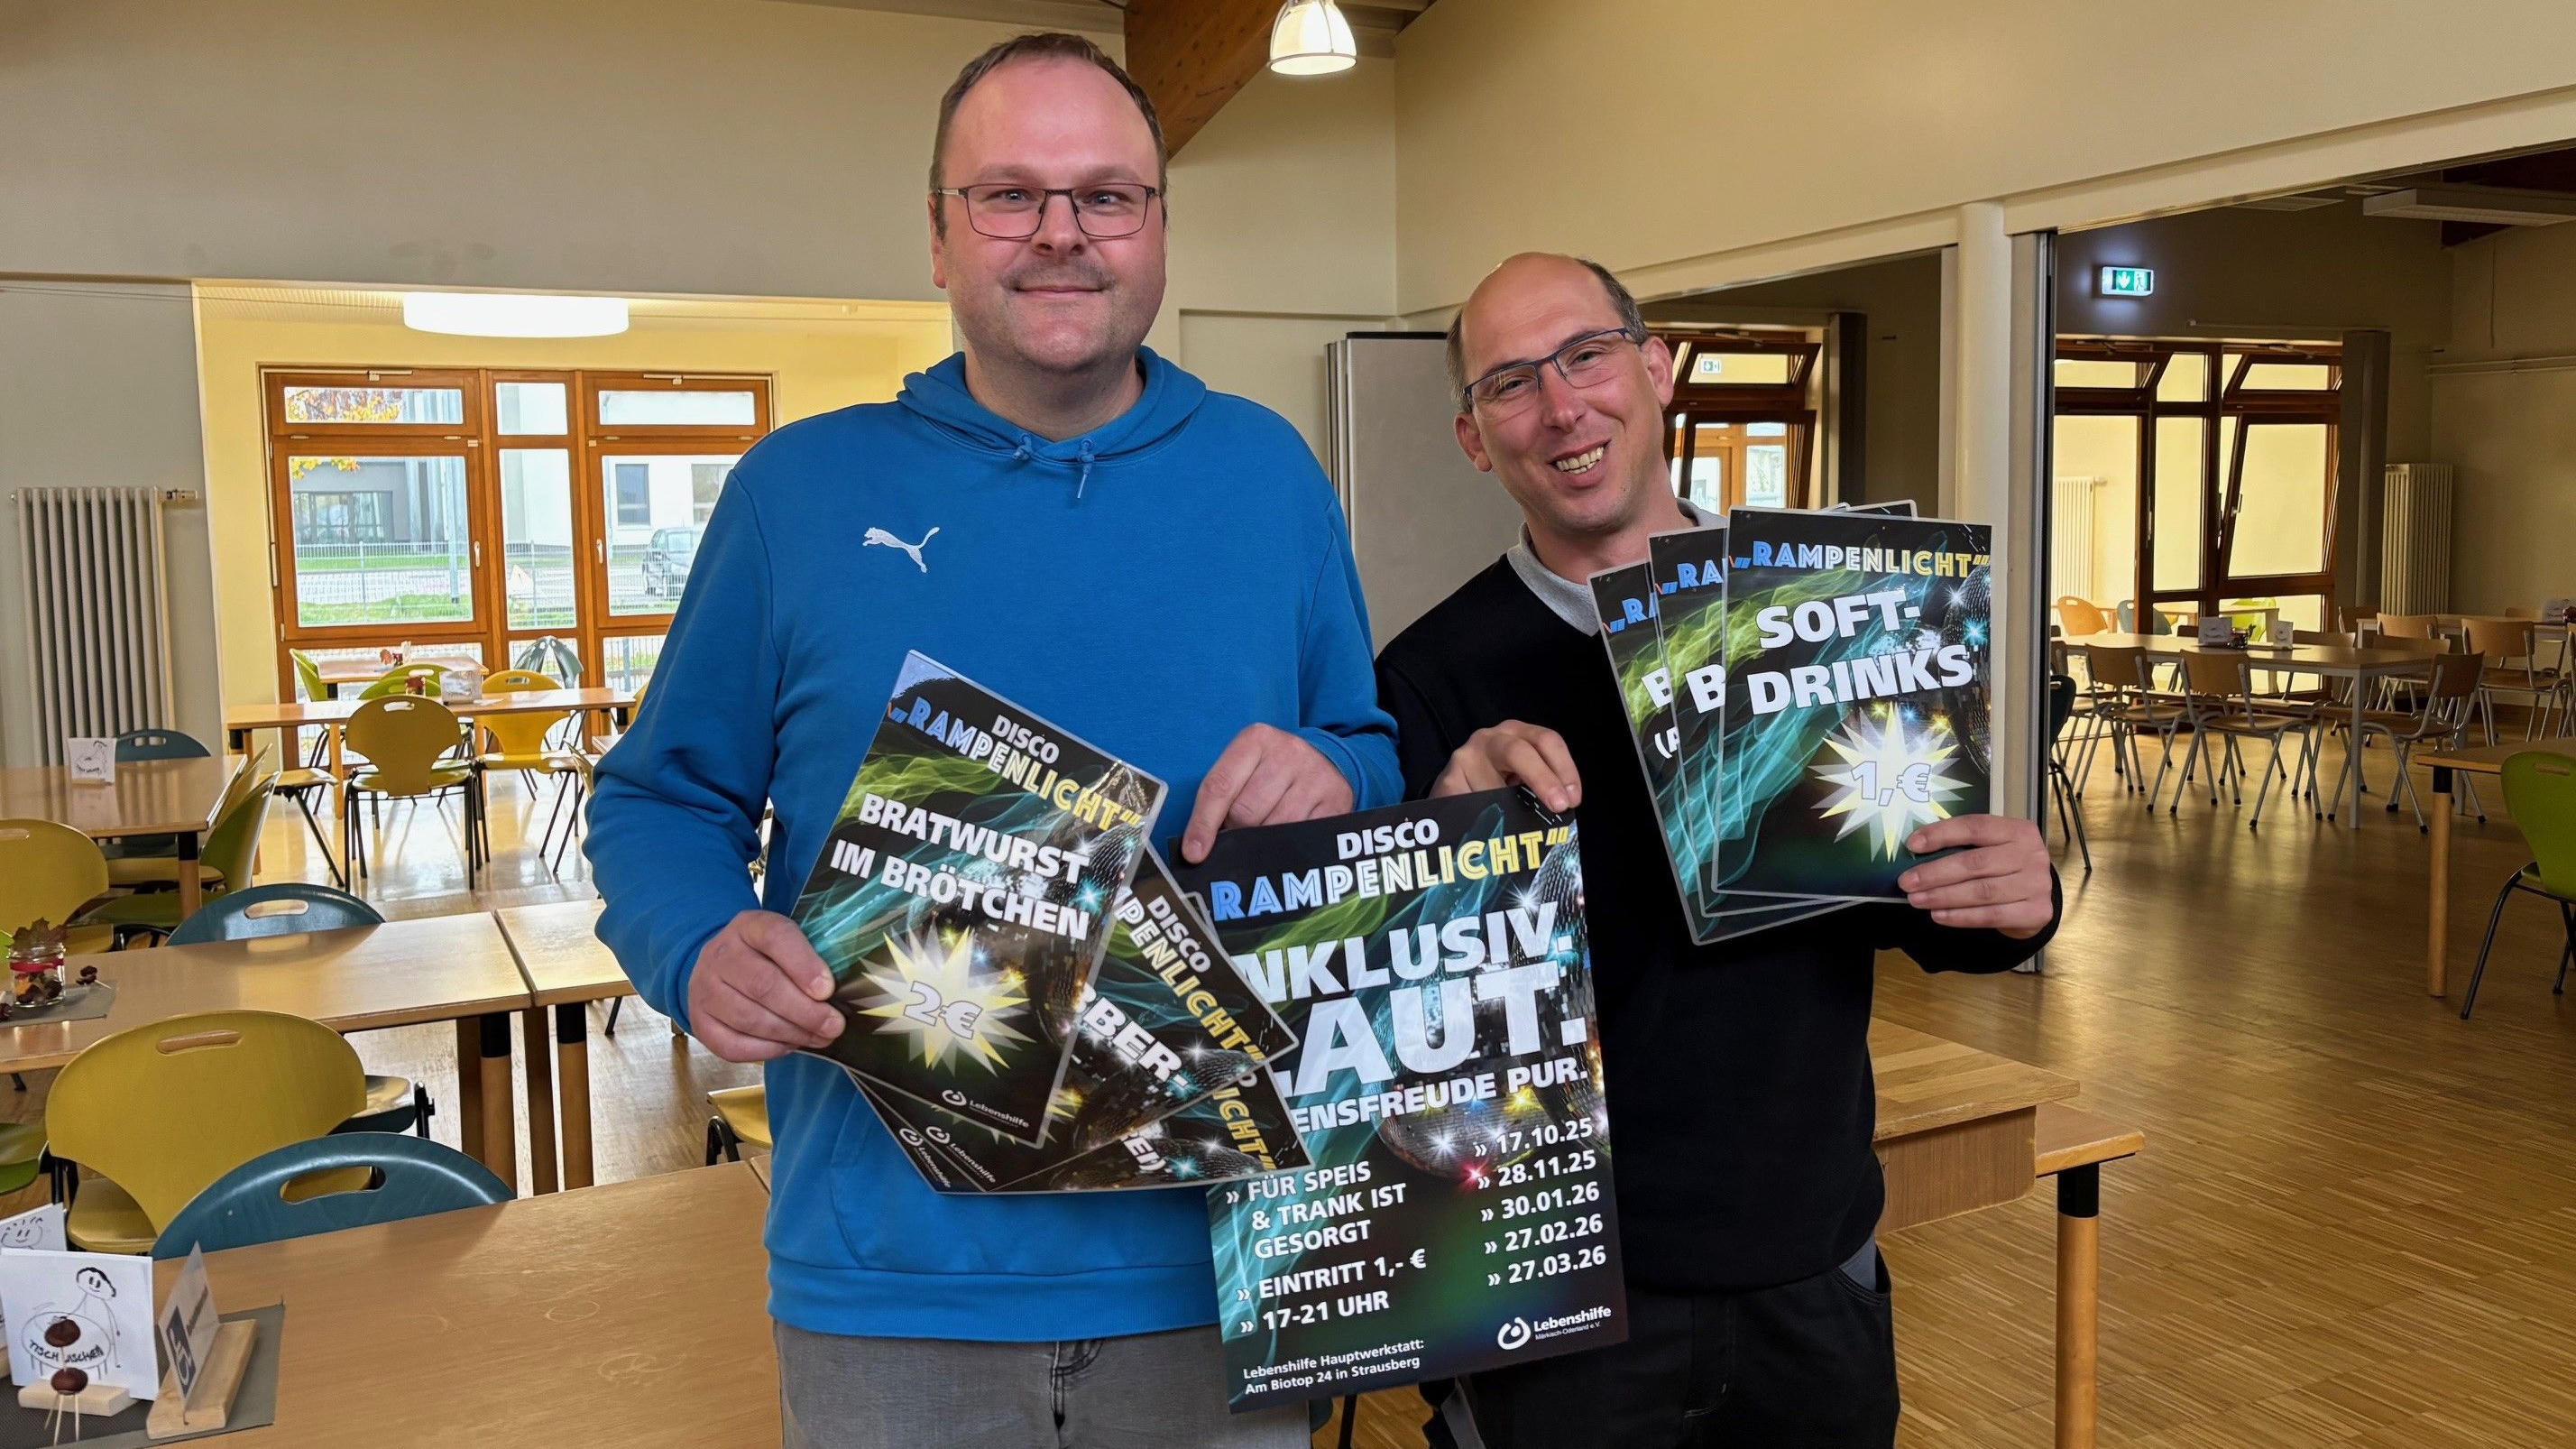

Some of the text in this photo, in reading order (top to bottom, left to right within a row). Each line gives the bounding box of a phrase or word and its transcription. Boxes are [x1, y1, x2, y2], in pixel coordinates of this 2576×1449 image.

[1756, 589, 1921, 649] SOFT-
[1746, 644, 1973, 715] DRINKS
[991, 714, 1060, 764] DISCO
[858, 792, 1090, 885] BRATWURST
[1336, 819, 1440, 860] DISCO
[830, 839, 1090, 941] IM BRÖTCHEN
[1146, 894, 1211, 973] DISCO
[1230, 901, 1573, 1003] NKLUSIV.
[969, 1099, 1030, 1129] Lebenshilfe
[1292, 1074, 1497, 1134] ENSFREUDE
[1507, 1057, 1588, 1094] PUR.
[1495, 1118, 1593, 1154] 17.10.25
[1247, 1175, 1296, 1202] FÜR
[1303, 1160, 1371, 1192] SPEIS
[1497, 1149, 1596, 1187] 28.11.25
[1252, 1183, 1406, 1231] & TRANK IST
[1501, 1181, 1600, 1219] 30.01.26
[1254, 1219, 1372, 1259] GESORGT
[1504, 1214, 1603, 1251] 27.02.26
[1258, 1260, 1366, 1299] EINTRITT
[1508, 1245, 1606, 1284] 27.03.26
[1263, 1301, 1329, 1331] 17-21
[1337, 1290, 1390, 1317] UHR
[1533, 1306, 1612, 1333] Lebenshilfe
[1243, 1339, 1424, 1380] Lebenshilfe Hauptwerkstatt:
[1245, 1357, 1421, 1396] Am Biotop 24 in Strausberg
